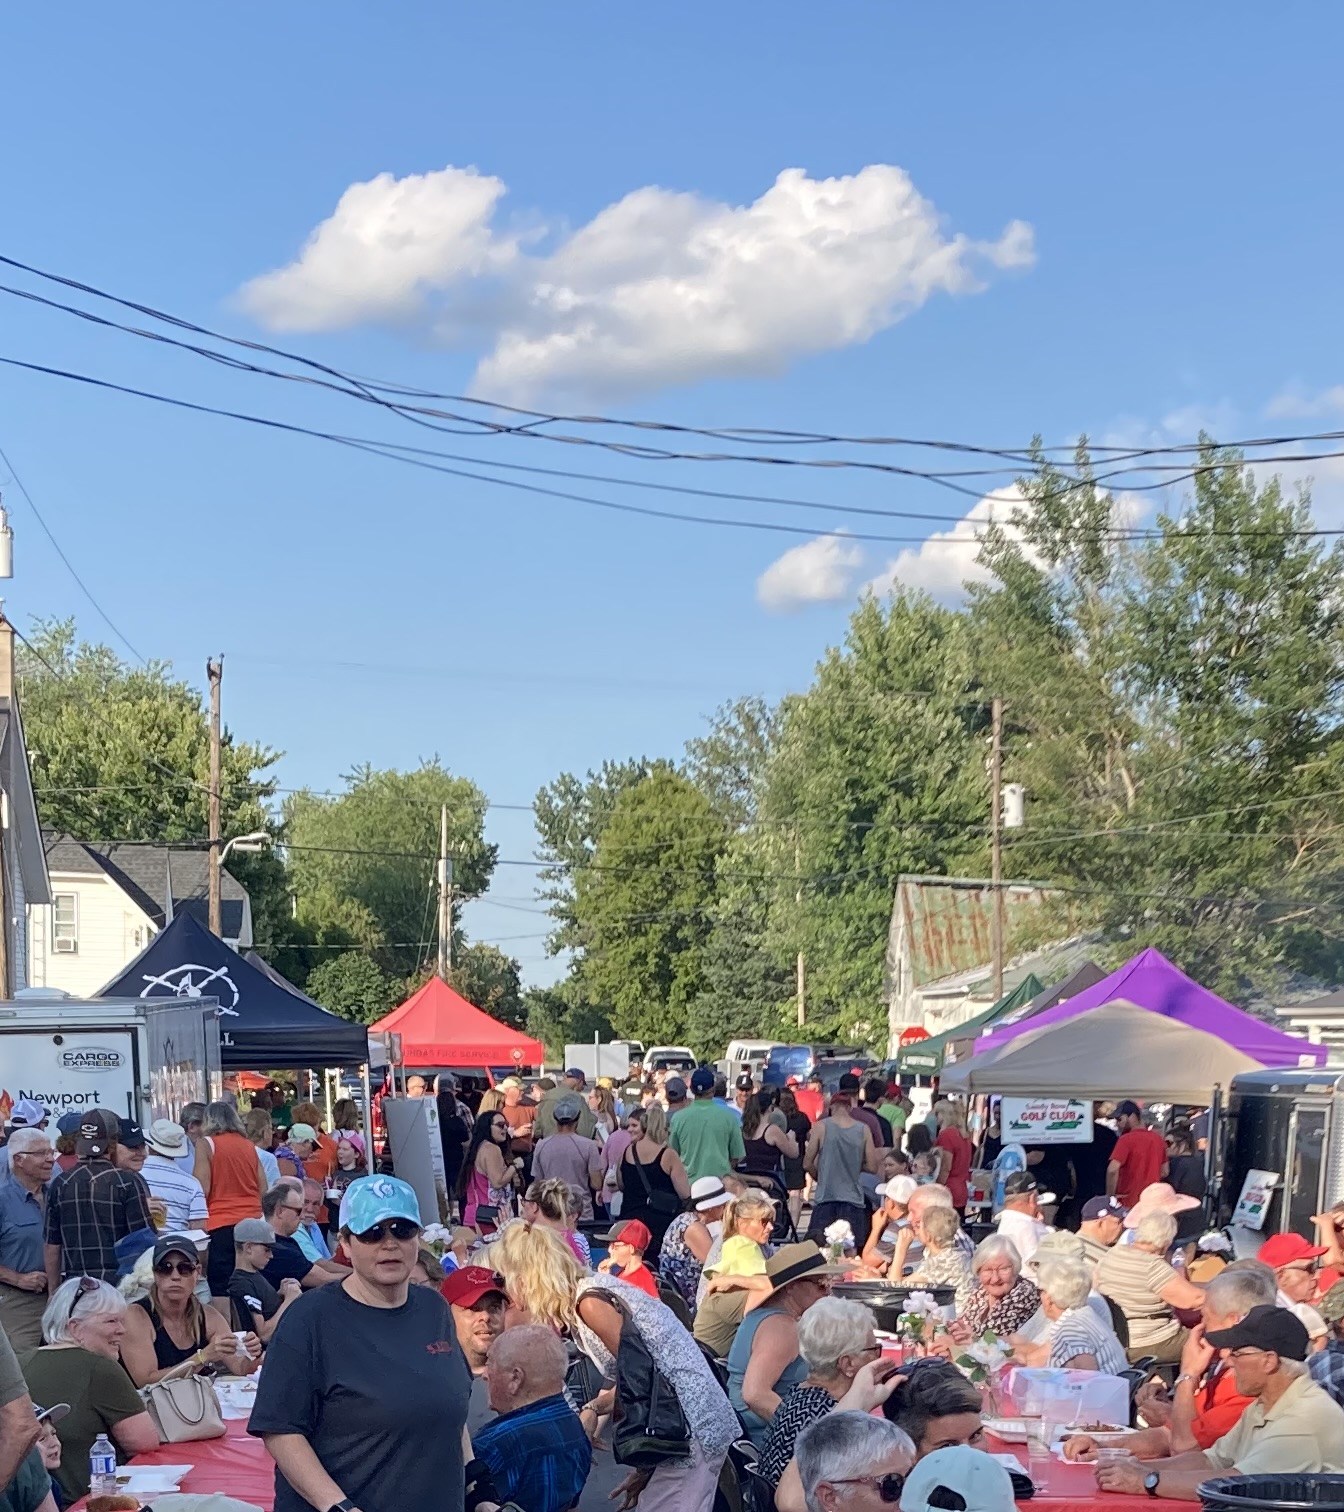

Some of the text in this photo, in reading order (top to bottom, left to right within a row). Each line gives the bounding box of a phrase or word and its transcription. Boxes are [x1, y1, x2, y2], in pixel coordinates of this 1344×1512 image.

[63, 1052, 119, 1061] CARGO
[19, 1089, 101, 1108] Newport
[1020, 1111, 1076, 1121] GOLF CLUB
